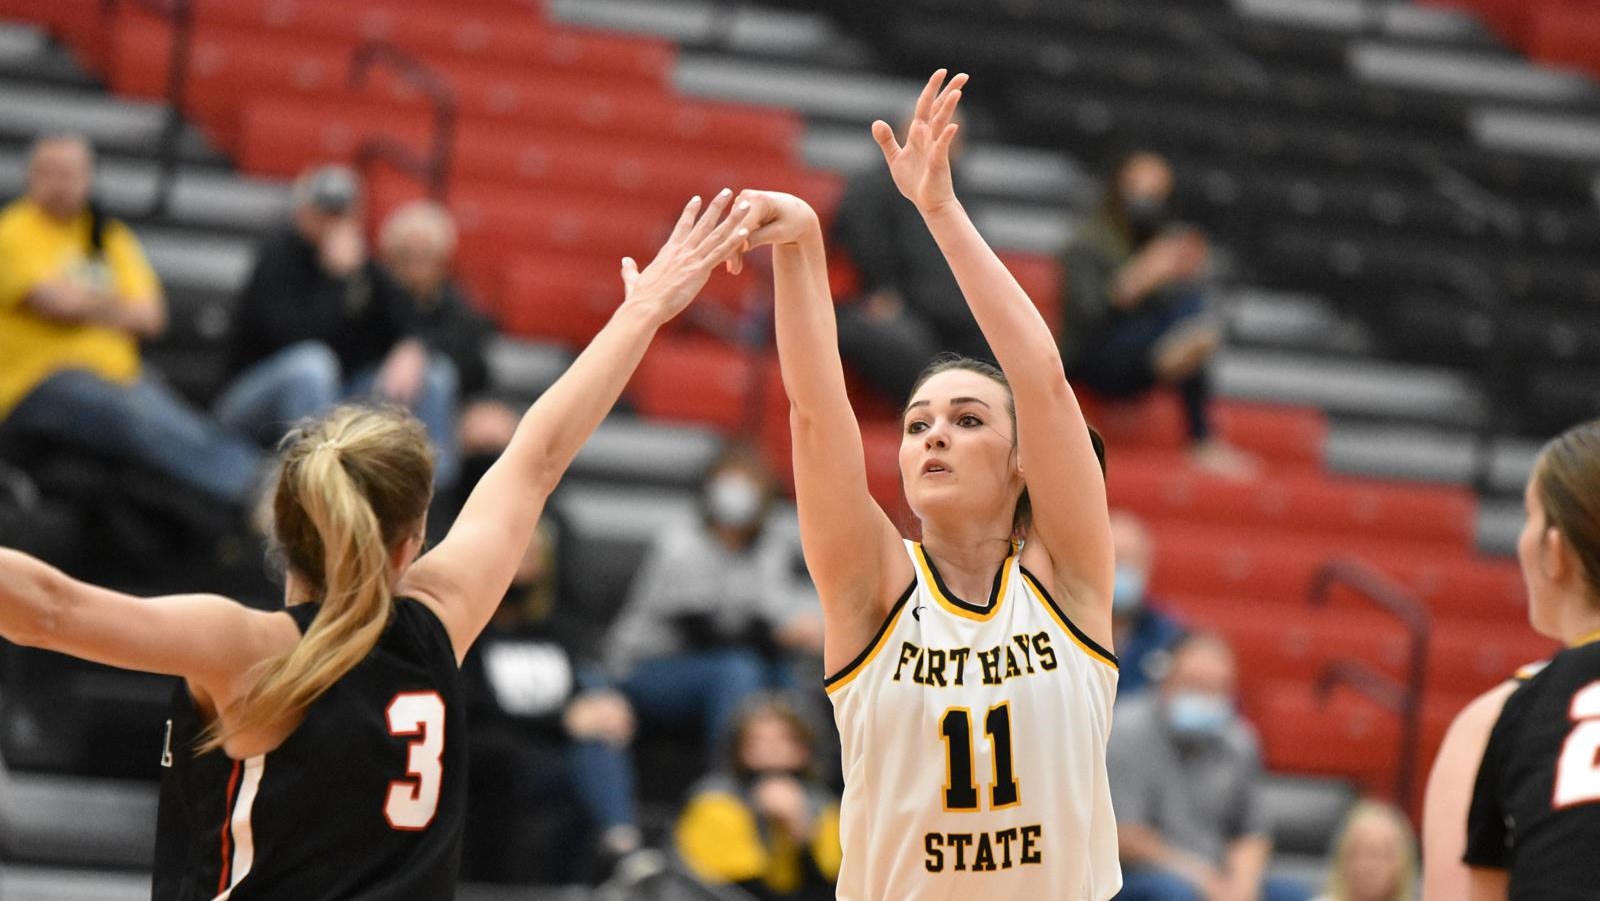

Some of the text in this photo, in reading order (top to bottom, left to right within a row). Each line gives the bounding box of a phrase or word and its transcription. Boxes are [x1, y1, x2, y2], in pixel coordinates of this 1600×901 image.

[976, 631, 1058, 686] HAYS
[384, 690, 446, 831] 3
[938, 700, 1022, 813] 11
[924, 824, 1042, 873] STATE
